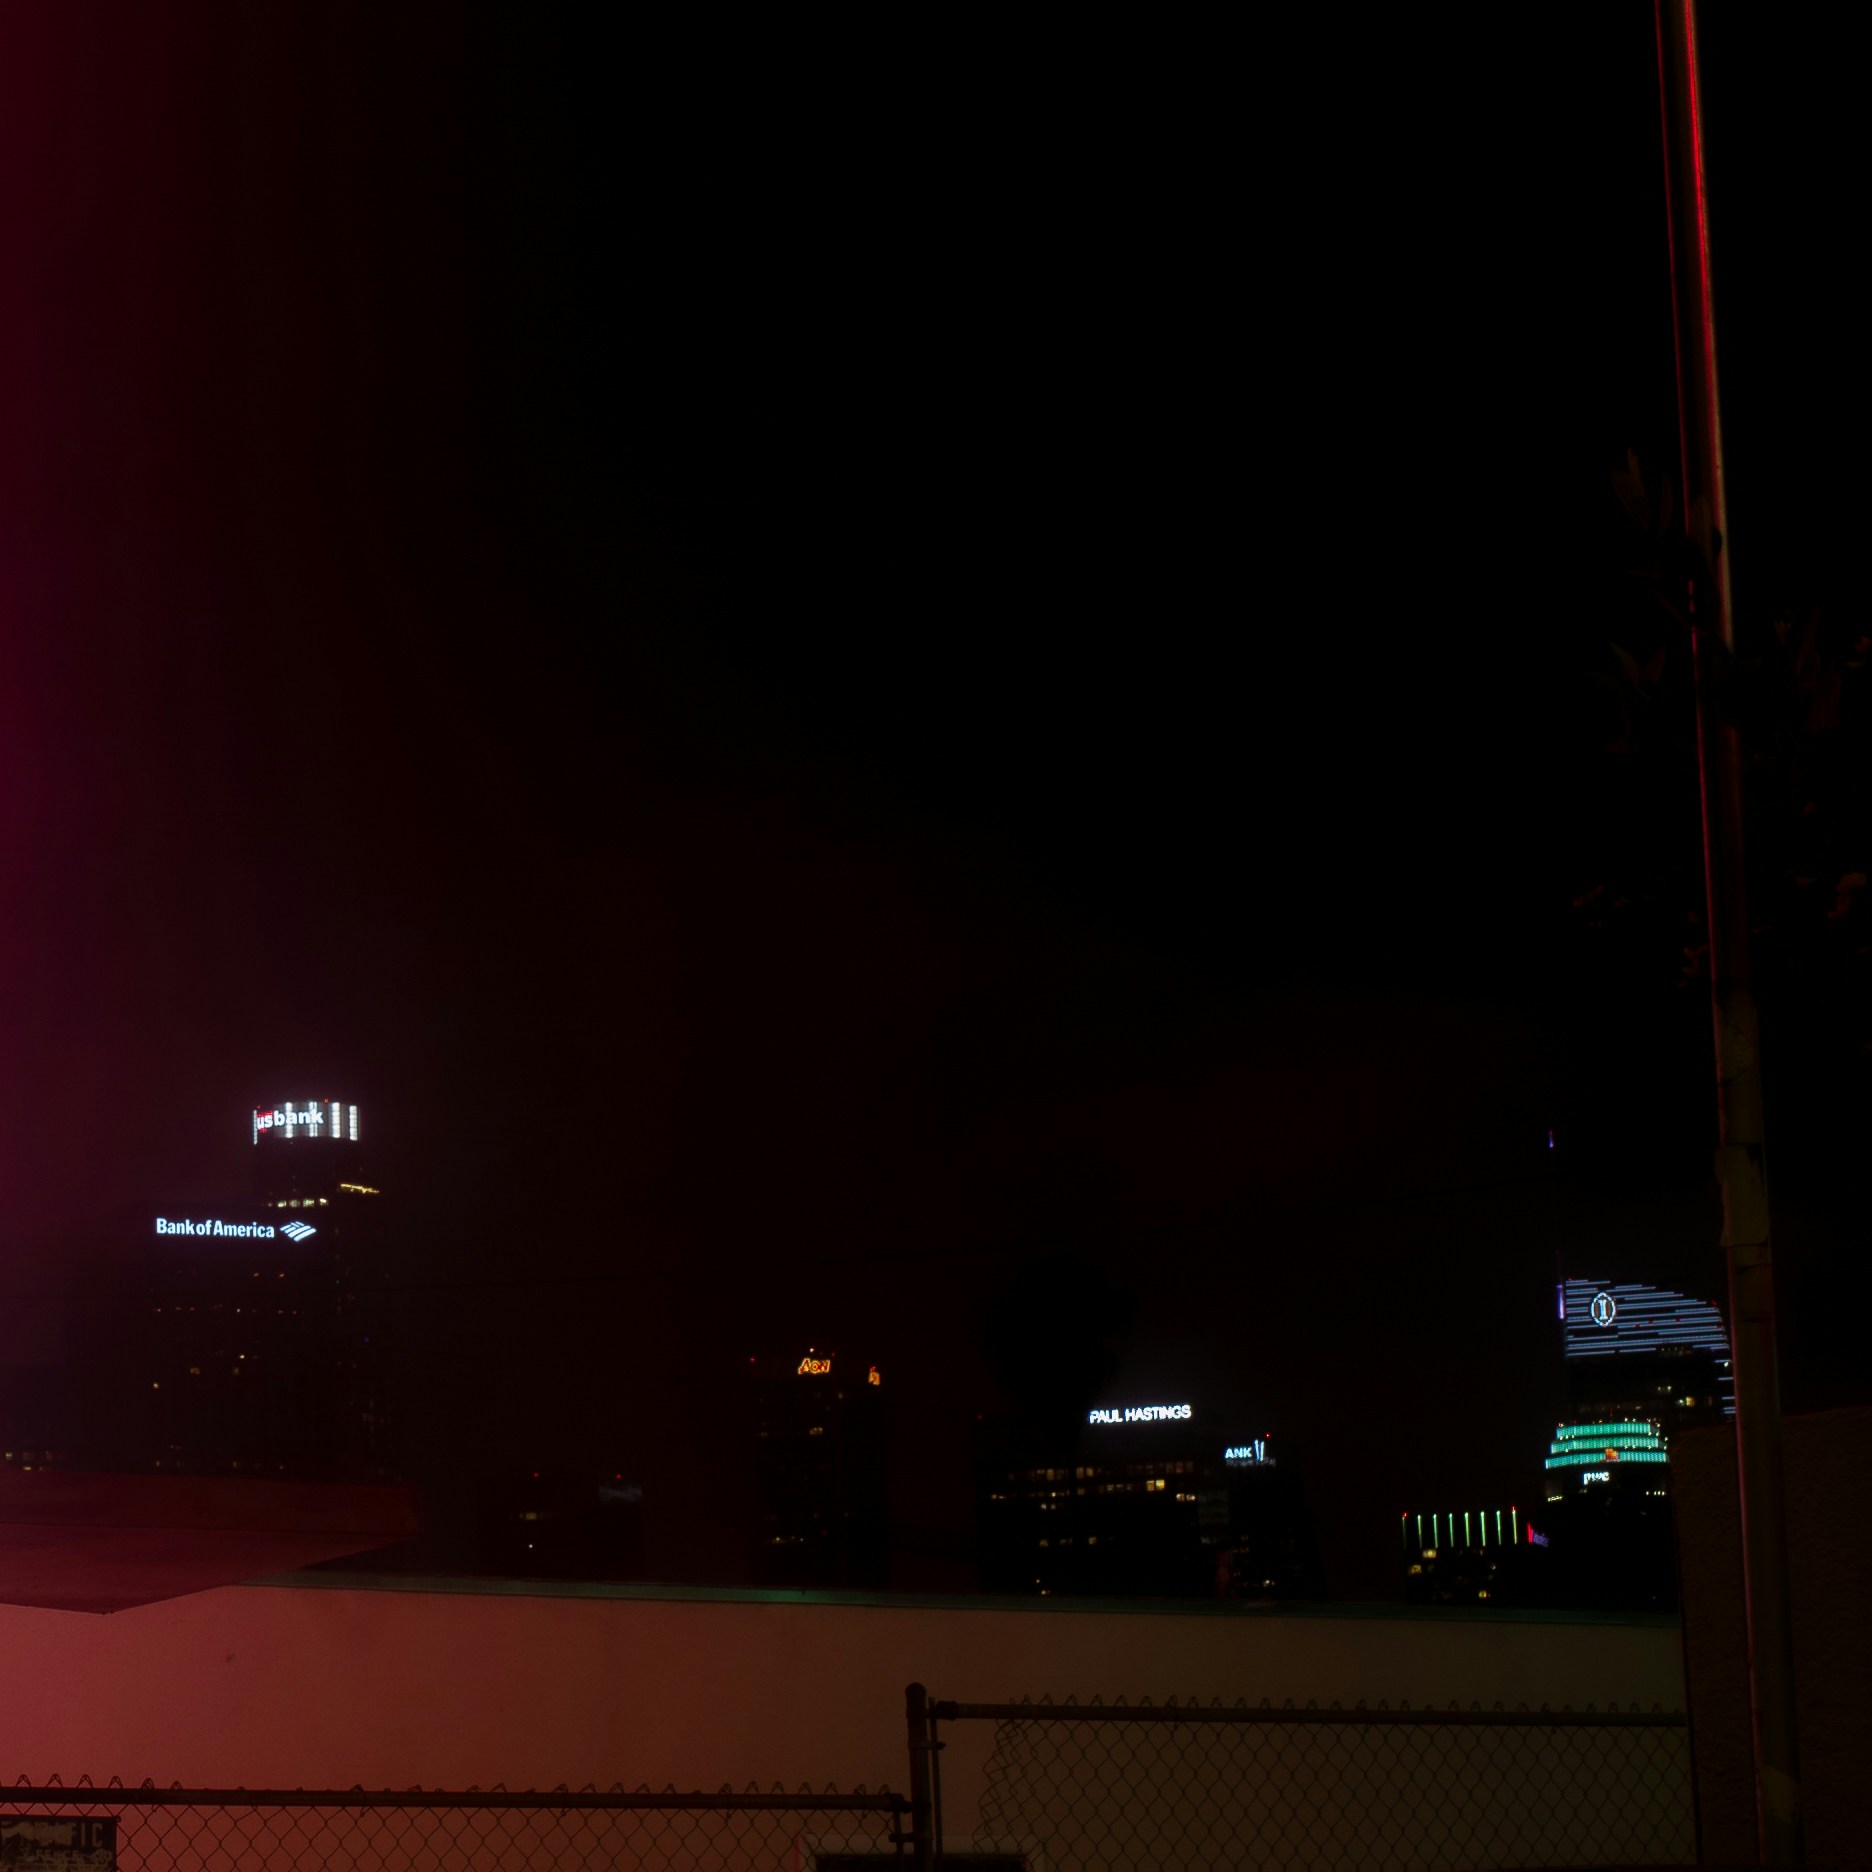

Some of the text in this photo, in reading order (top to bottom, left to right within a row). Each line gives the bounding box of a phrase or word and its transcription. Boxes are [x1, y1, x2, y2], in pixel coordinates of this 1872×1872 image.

[213, 1220, 275, 1239] America
[1089, 1404, 1192, 1424] PAUL HASTINGS
